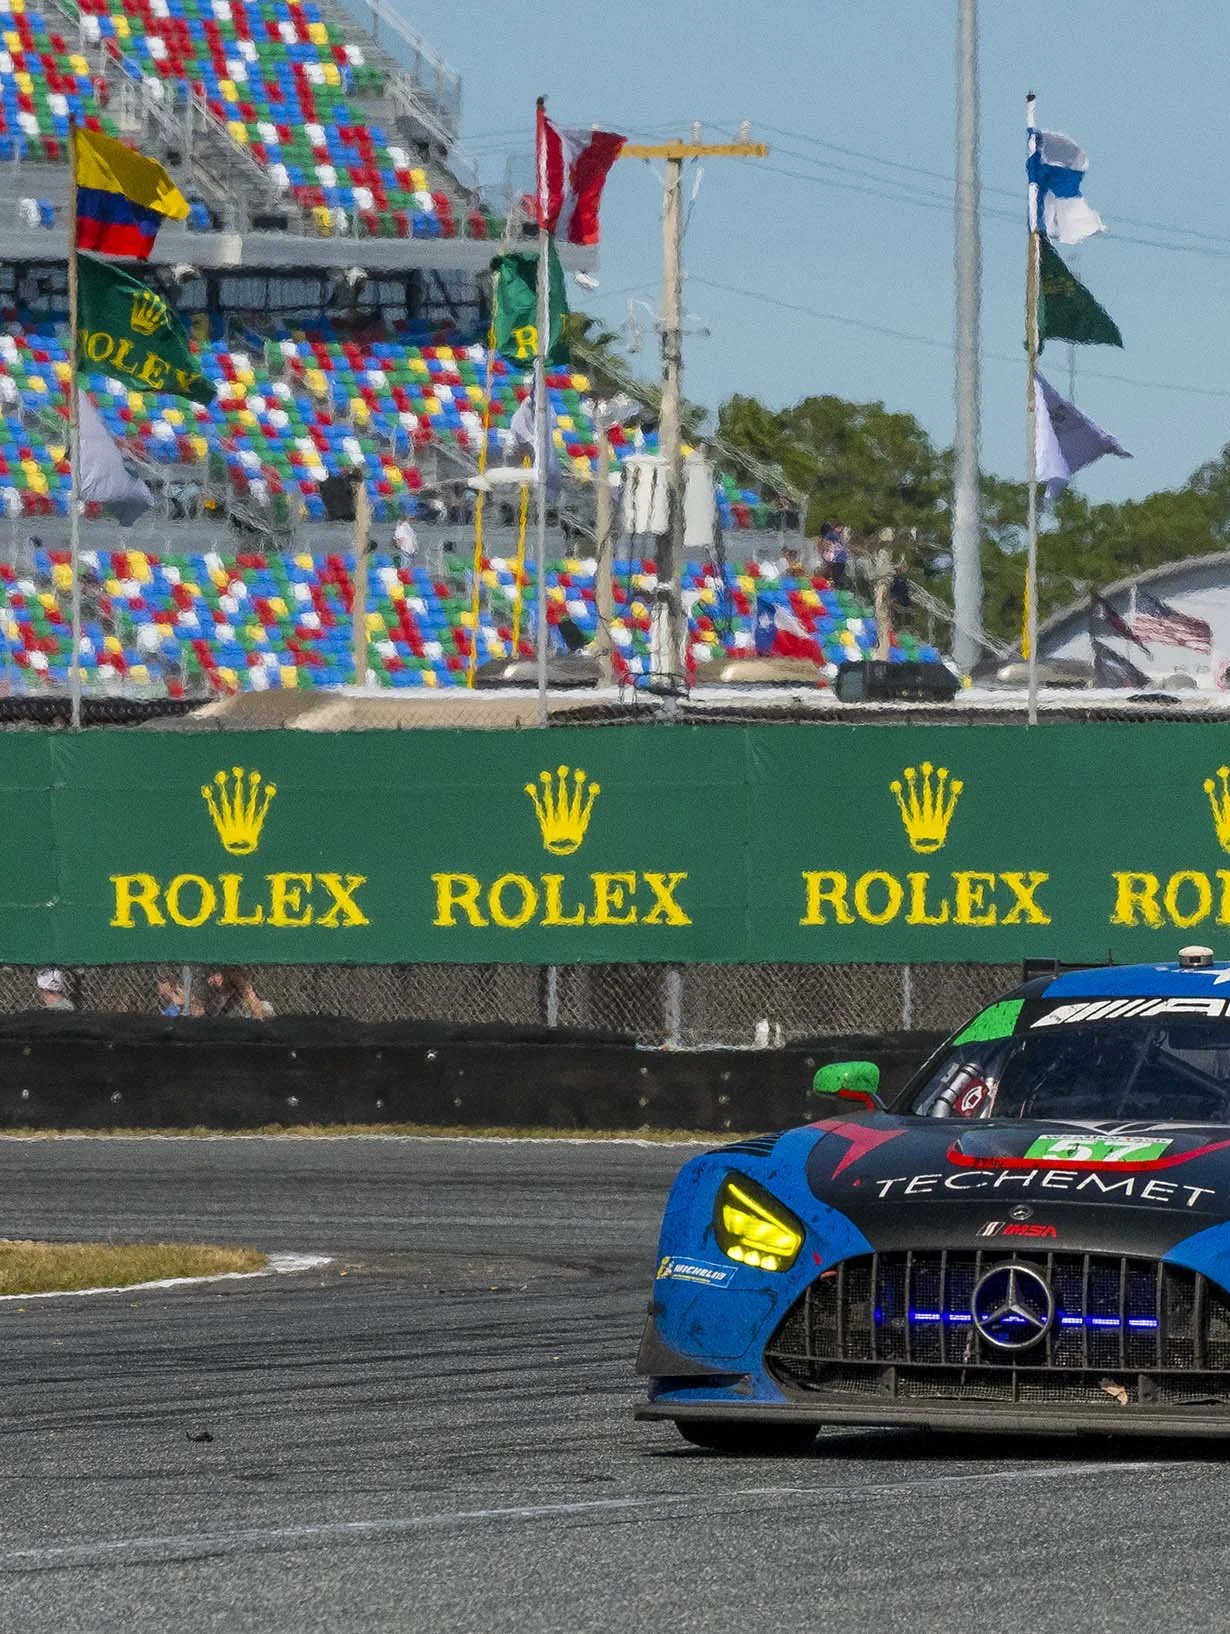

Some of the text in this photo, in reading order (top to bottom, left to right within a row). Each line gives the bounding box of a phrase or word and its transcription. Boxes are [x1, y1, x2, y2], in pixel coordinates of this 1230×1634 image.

[110, 872, 369, 928] ROLEX
[431, 871, 692, 928] ROLEX
[800, 870, 1051, 927] ROLEX
[1042, 1139, 1153, 1162] 57
[876, 1168, 1216, 1208] TECHEMET
[673, 1264, 727, 1281] MICHELIN
